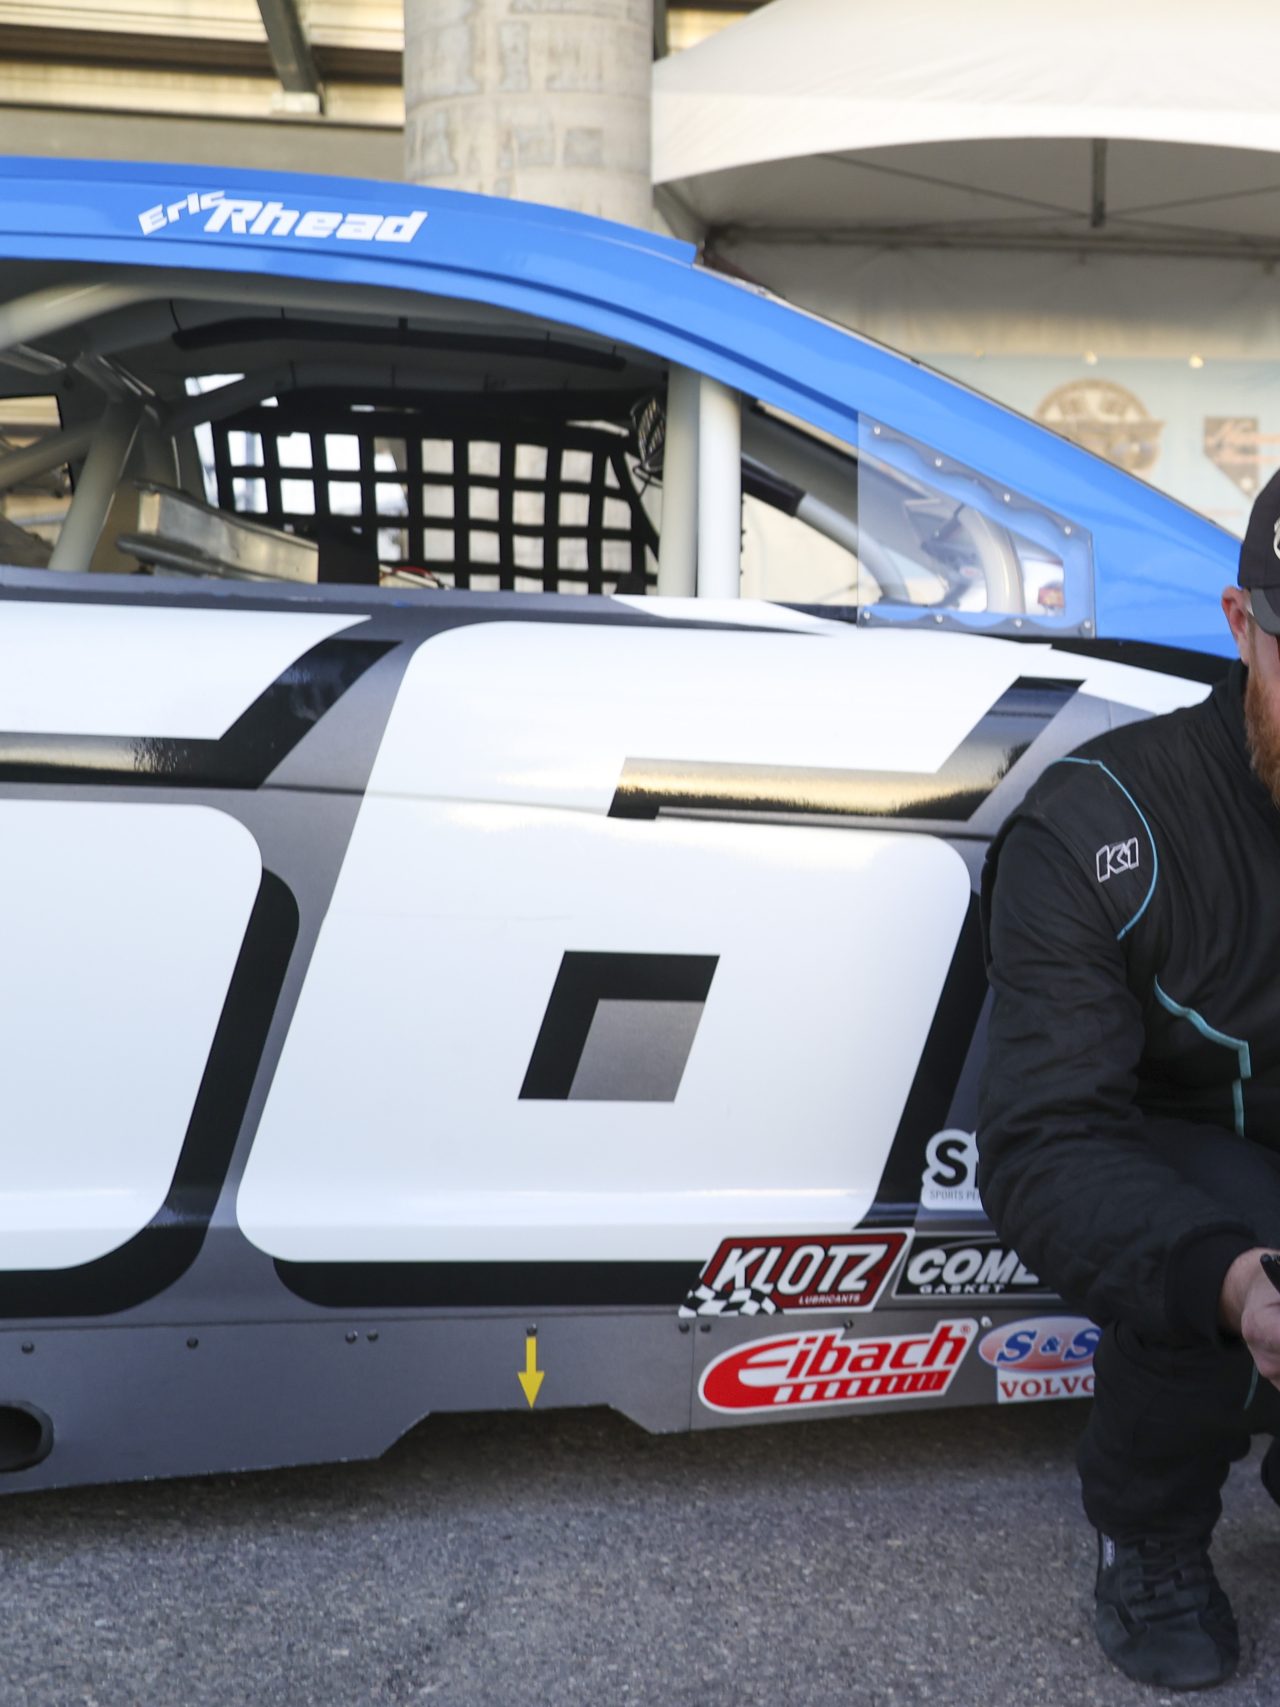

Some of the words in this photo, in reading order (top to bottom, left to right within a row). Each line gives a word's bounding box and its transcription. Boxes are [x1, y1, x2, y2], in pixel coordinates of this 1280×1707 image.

[204, 199, 428, 243] Rhead
[711, 1244, 889, 1296] KLOTZ
[919, 1283, 1005, 1294] GASKET
[799, 1293, 861, 1305] LUBRICANTS
[703, 1324, 967, 1409] Eibach
